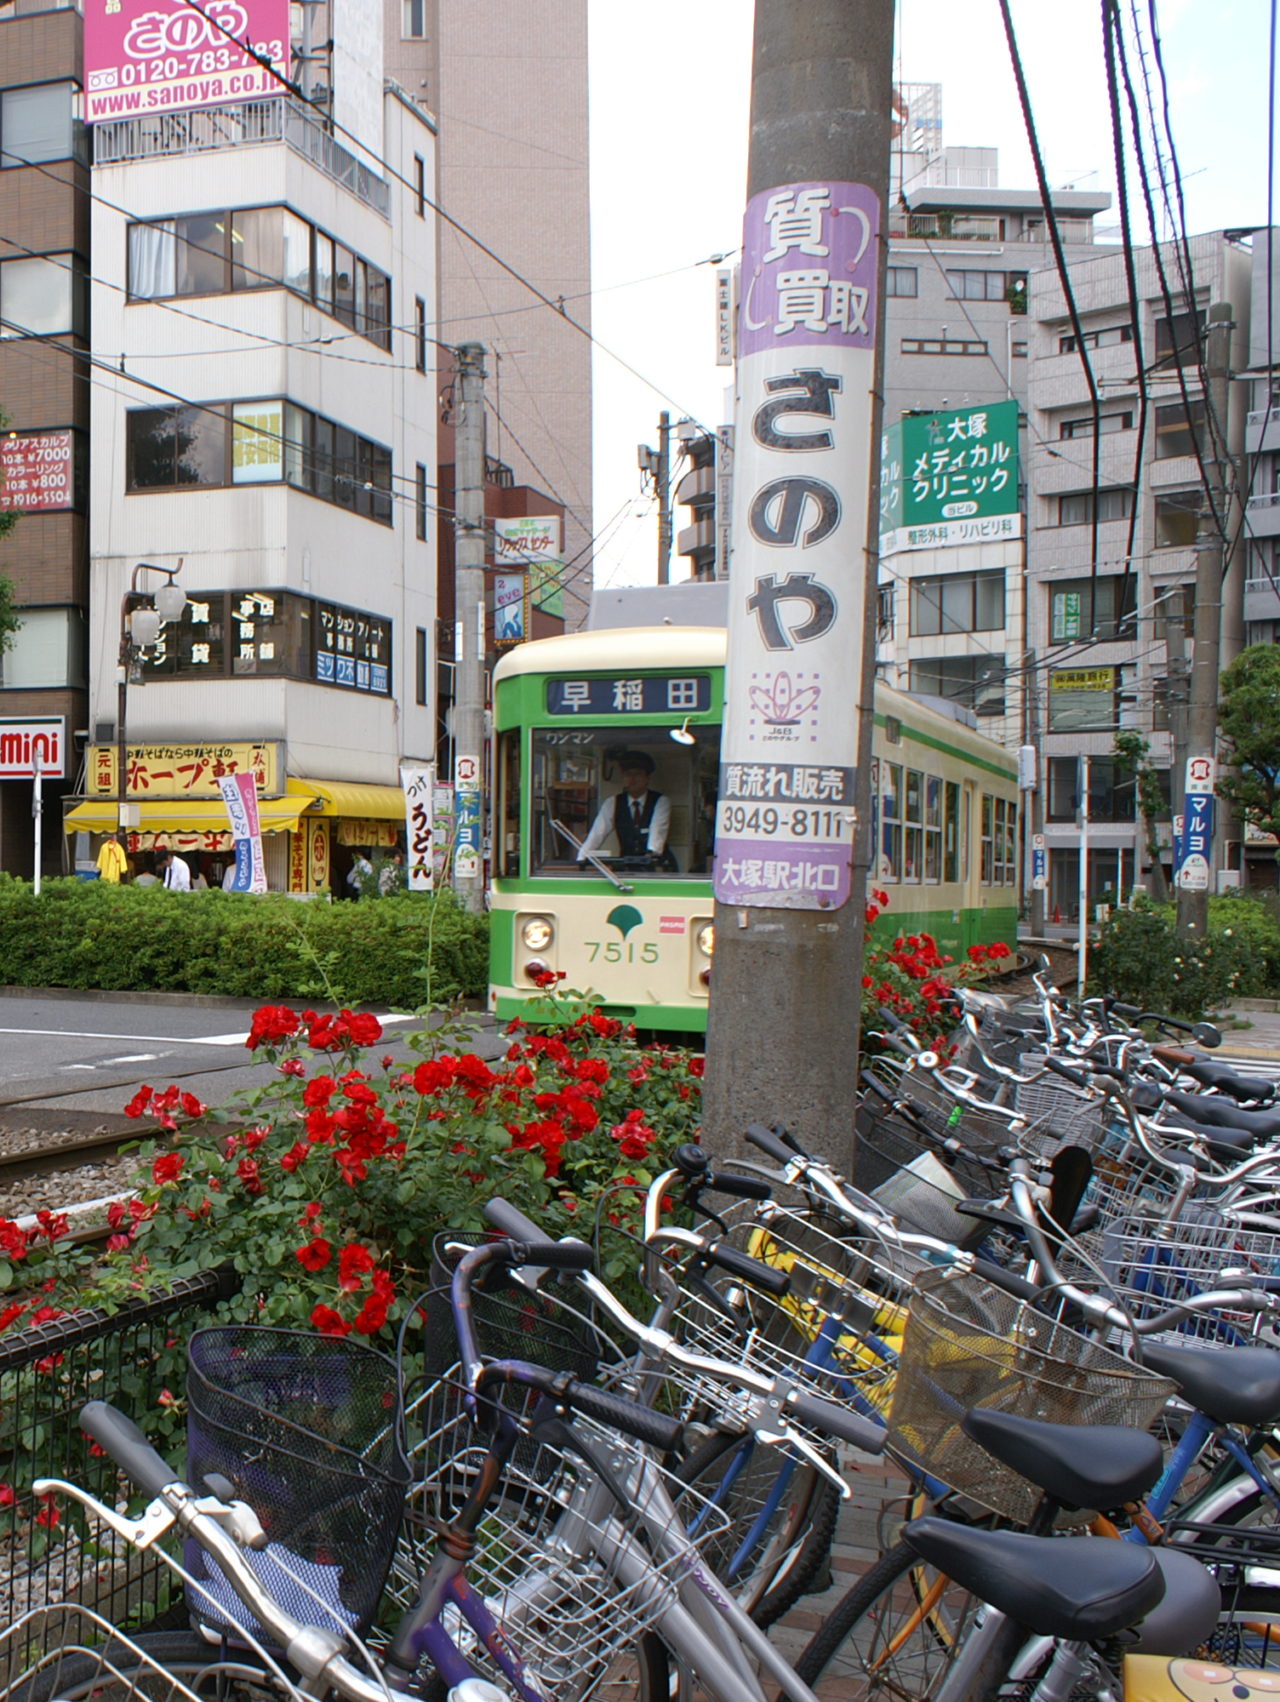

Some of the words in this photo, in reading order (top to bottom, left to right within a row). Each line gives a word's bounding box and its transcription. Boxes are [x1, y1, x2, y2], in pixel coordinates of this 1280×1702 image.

[124, 1, 248, 58] さのや
[121, 40, 283, 86] 0120-783-783
[91, 69, 282, 116] www.sanoya.co.jp
[762, 188, 830, 264] 質
[774, 268, 869, 336] 買取
[947, 412, 987, 442] 大塚
[7, 462, 64, 477] カラーリング
[28, 446, 69, 463] ¥7000
[913, 440, 1011, 477] メディカル
[32, 474, 66, 489] ¥800
[913, 467, 1008, 502] クリニック
[745, 368, 843, 652] さのや
[240, 599, 255, 660] 事務所
[561, 679, 698, 712] 早稲田
[546, 733, 594, 744] ワンマン
[97, 754, 112, 787] 元祖
[725, 766, 844, 800] 質流れ販売
[723, 807, 842, 837] 3949-8111
[1189, 797, 1207, 851] マルヨ
[411, 802, 432, 879] うどん
[721, 858, 840, 890] 大塚駅北口
[584, 942, 659, 963] 7515
